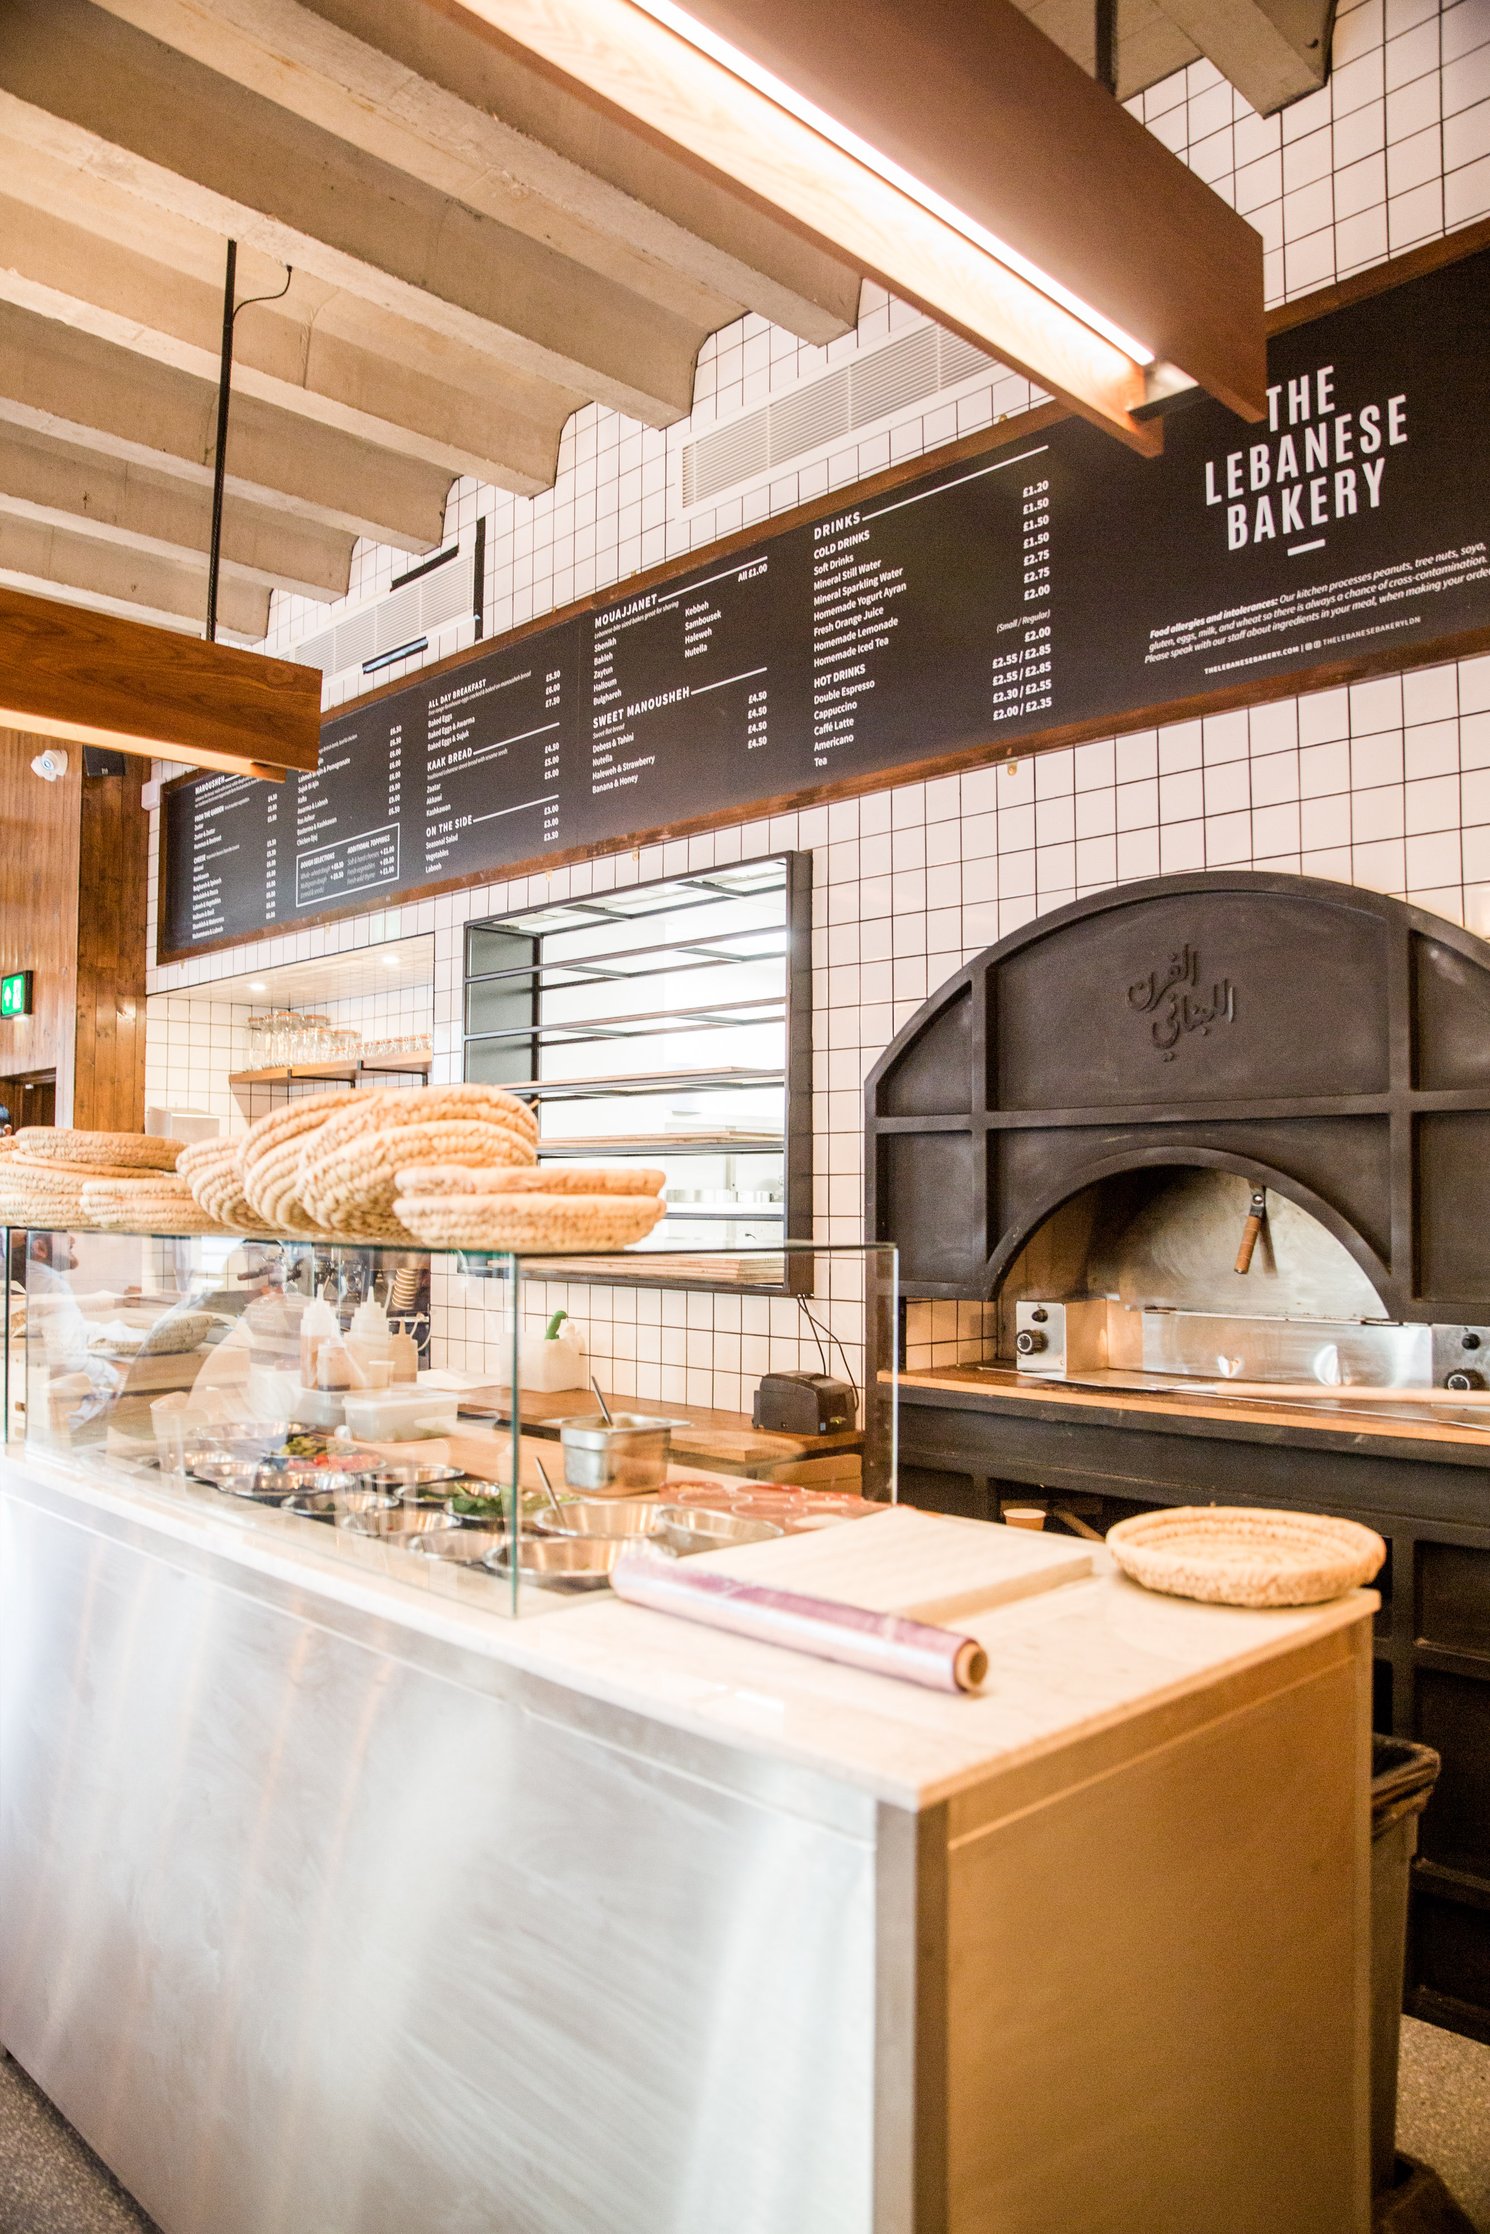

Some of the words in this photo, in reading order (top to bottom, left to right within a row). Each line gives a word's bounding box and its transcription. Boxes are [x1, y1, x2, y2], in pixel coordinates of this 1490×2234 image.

[1266, 365, 1335, 432] THE
[1206, 394, 1407, 506] LEBANESE
[1022, 480, 1049, 497] £1.20
[1023, 497, 1049, 514] £1.50
[1227, 457, 1385, 551] BAKERY
[814, 511, 860, 540] DRINKS
[1023, 514, 1049, 532] £1.50
[813, 543, 836, 559] COLD
[837, 529, 869, 550] DRINKS
[1023, 531, 1049, 549] £1.50
[813, 562, 828, 575] Soft
[829, 554, 854, 569] Drinks
[1023, 549, 1049, 566] £2.75
[737, 570, 747, 582] All
[748, 563, 767, 578] £1.00
[813, 572, 841, 590] Mineral
[842, 566, 857, 580] Still
[858, 559, 881, 574] Water
[1023, 566, 1050, 583] £2.75
[813, 587, 841, 606] Mineral
[842, 576, 878, 596] Sparkling
[879, 567, 903, 582] Water
[1023, 584, 1050, 600] £2.00
[1149, 625, 1170, 638] Food
[1169, 617, 1205, 633] allergies
[1205, 611, 1223, 623] and
[1223, 598, 1278, 619] intolerances:
[1279, 593, 1295, 603] Our
[1296, 584, 1328, 599] kitchen
[1328, 572, 1372, 592] processes
[1372, 562, 1413, 581] peanuts,
[1414, 556, 1434, 567] tree
[1435, 549, 1459, 562] nuts,
[1460, 542, 1486, 555] soya,
[594, 593, 658, 629] MOUAJJANET
[685, 600, 709, 617] Kebbeh
[813, 599, 856, 621] Homemade
[856, 589, 882, 606] Yogurt
[883, 582, 906, 597] Ayran
[1148, 638, 1175, 653] gluten,
[1175, 632, 1197, 644] eggs,
[1198, 625, 1217, 637] milk,
[1218, 619, 1235, 632] and
[1235, 613, 1262, 627] wheat
[1262, 612, 1273, 621] so
[1273, 606, 1296, 618] there
[1296, 602, 1304, 611] is
[1305, 595, 1336, 609] always
[1336, 593, 1343, 601] a
[1344, 584, 1377, 599] chance
[1377, 578, 1388, 590] of
[1388, 555, 1487, 587] cross-contamination.
[684, 609, 721, 630] Sambousek
[813, 622, 834, 636] Fresh
[834, 614, 862, 629] Orange
[863, 606, 884, 620] Juice
[1144, 651, 1169, 663] Please
[1170, 643, 1193, 658] speak
[1193, 638, 1211, 651] with
[1212, 636, 1226, 646] our
[1227, 629, 1246, 642] staff
[1246, 624, 1271, 637] about
[1272, 612, 1320, 631] ingredients
[1320, 609, 1330, 618] in
[1330, 604, 1351, 618] your
[1351, 595, 1377, 610] meal,
[1378, 590, 1404, 603] when
[1405, 581, 1441, 596] making
[1442, 574, 1465, 589] your
[684, 627, 712, 644] Haleweh
[813, 630, 856, 652] Homemade
[857, 617, 898, 638] Lemonade
[1024, 626, 1051, 642] £2.00
[684, 643, 707, 658] Nutella
[813, 646, 856, 667] Homemade
[857, 639, 873, 653] Iced
[874, 637, 889, 647] Tea
[1204, 645, 1299, 674] THELEBANESEBAKERY.COM
[1322, 616, 1421, 645] THELEBANESEBAKERYLDN
[992, 652, 1017, 669] £2.55
[1024, 643, 1051, 659] £2.85
[813, 673, 832, 688] HOT
[833, 663, 865, 682] DRINKS
[992, 670, 1018, 686] £2.55
[1025, 660, 1051, 677] £2.85
[428, 698, 438, 709] ALL
[440, 692, 451, 704] DAY
[452, 678, 486, 699] BREAKFAST
[748, 690, 767, 704] £4.50
[813, 689, 840, 704] Double
[841, 679, 875, 696] Espresso
[992, 687, 1018, 703] £2.30
[1025, 678, 1051, 695] £2.55
[592, 708, 624, 728] SWEET
[626, 686, 689, 717] MANOUSHEH
[747, 705, 767, 719] £4.50
[813, 701, 857, 720] Cappuccino
[993, 705, 1018, 720] £2.00
[1025, 696, 1052, 712] £2.35
[427, 716, 441, 728] Baked
[747, 720, 767, 734] £4.50
[834, 717, 854, 730] Latte
[427, 727, 441, 739] Baked
[747, 735, 767, 749] £4.50
[813, 734, 854, 751] Americano
[427, 739, 441, 751] Baked
[427, 756, 446, 771] KAAK
[447, 747, 472, 764] BREAD
[592, 753, 612, 766] Nutella
[622, 755, 655, 771] Strawberry
[813, 756, 827, 766] Tea
[592, 781, 613, 794] Banana
[619, 774, 638, 785] Honey
[425, 825, 436, 837] ON
[438, 820, 452, 833] THE
[454, 814, 472, 828] SIDE
